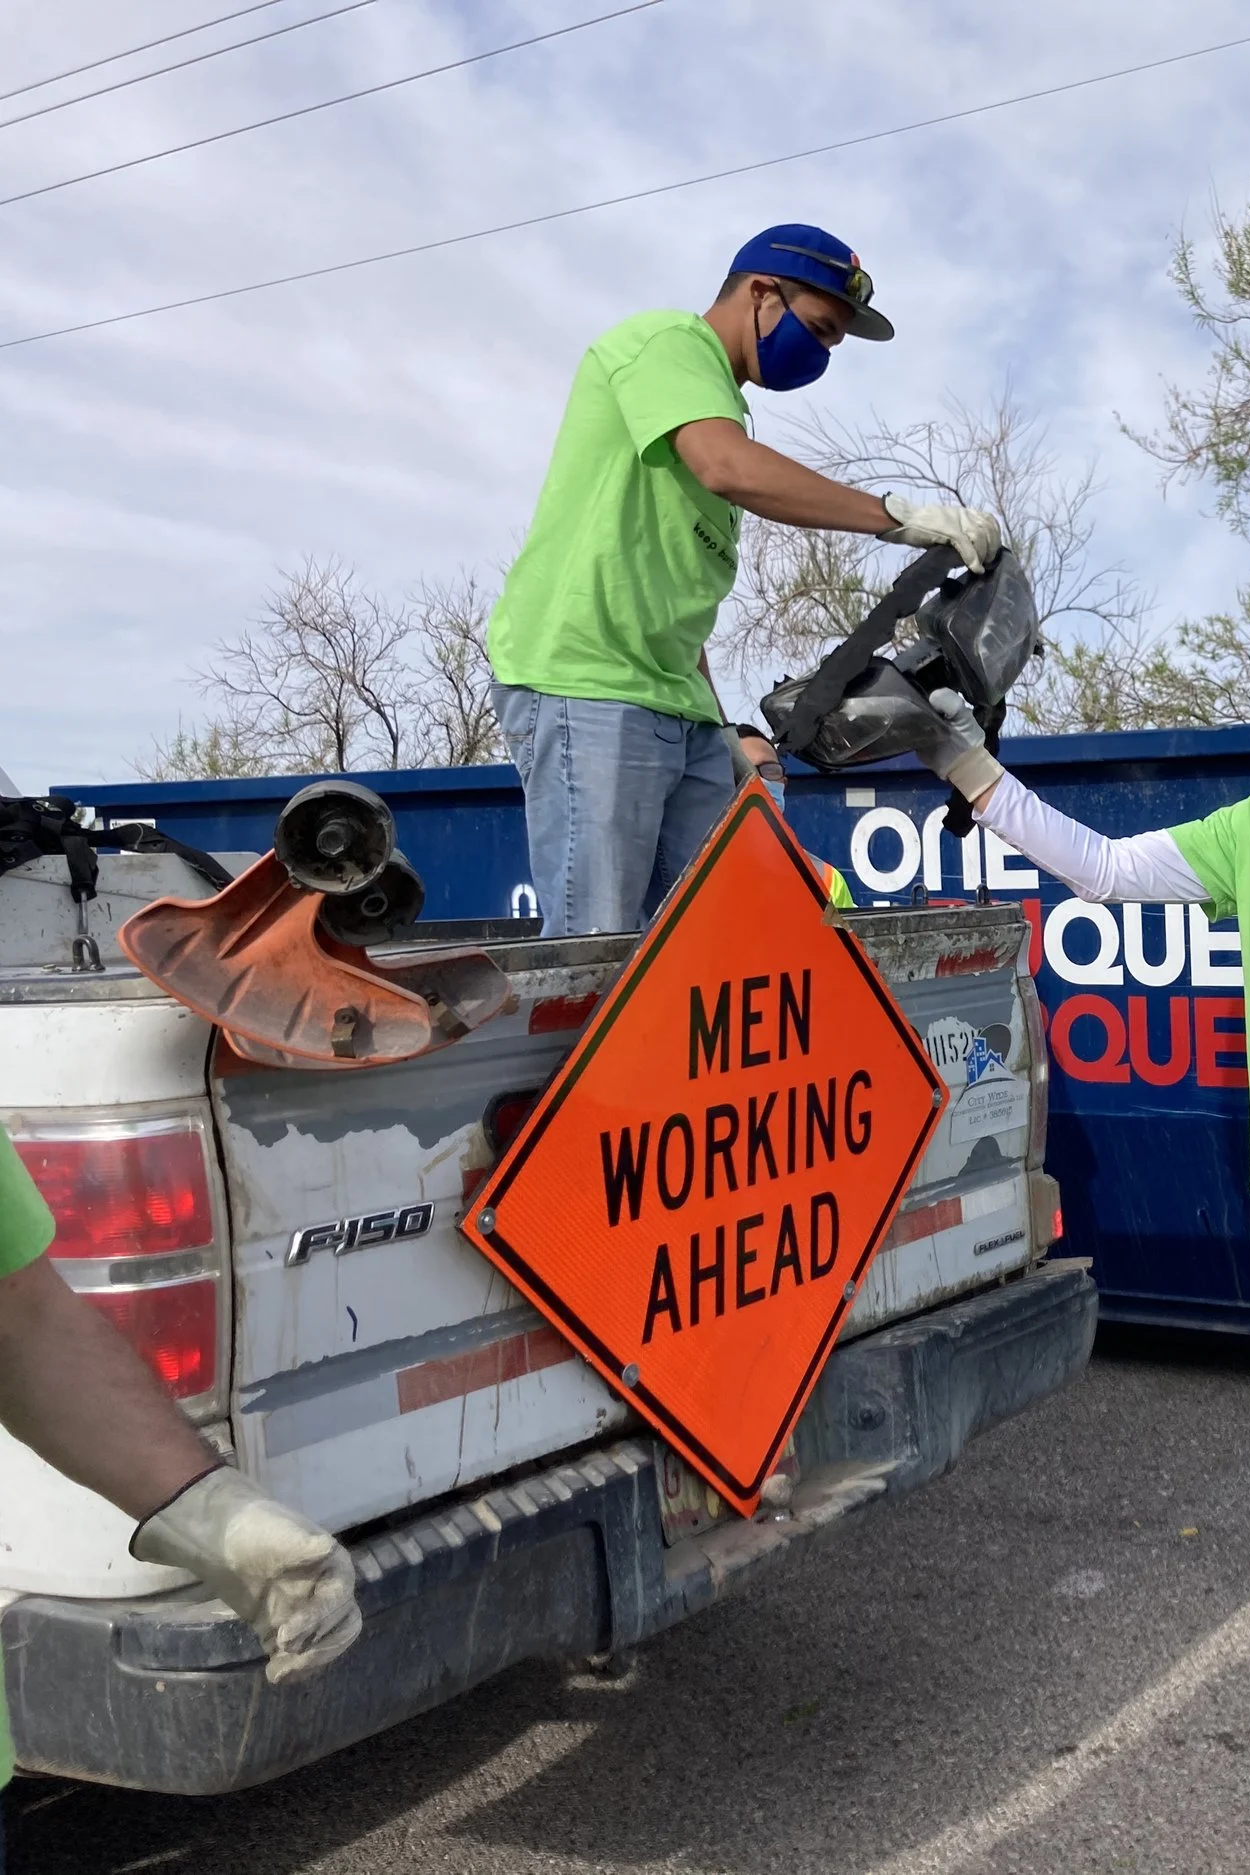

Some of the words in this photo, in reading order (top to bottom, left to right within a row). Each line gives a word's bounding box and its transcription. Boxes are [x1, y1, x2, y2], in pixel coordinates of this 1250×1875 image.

[692, 522, 717, 550] keep
[688, 968, 812, 1081] MEN
[600, 1069, 873, 1228] WORKING
[641, 1191, 840, 1345] AHEAD
